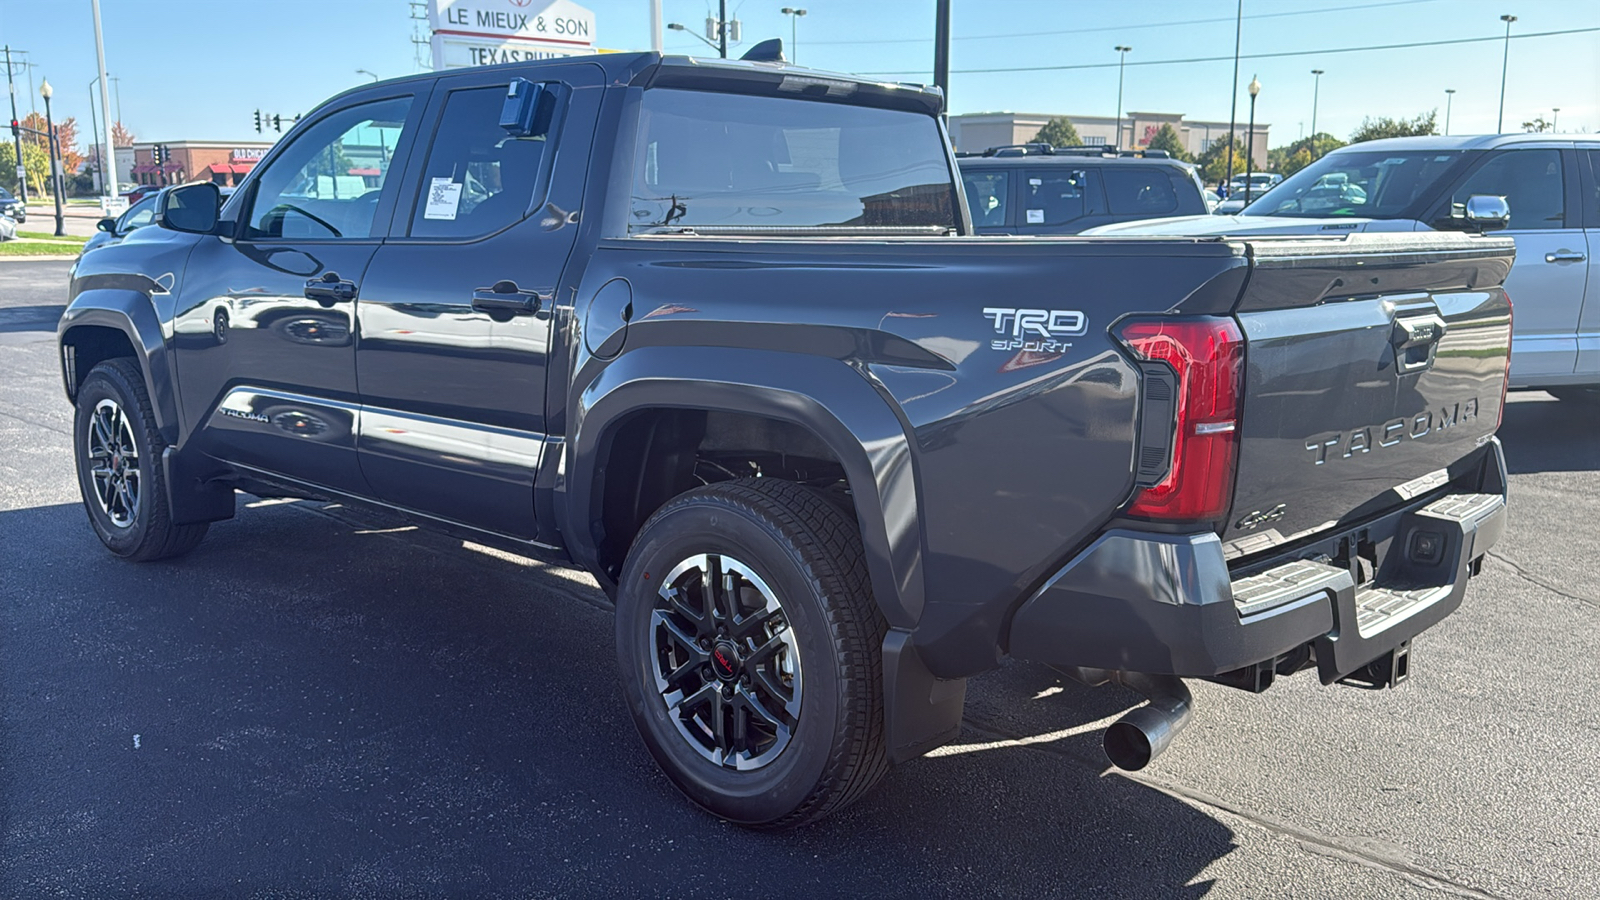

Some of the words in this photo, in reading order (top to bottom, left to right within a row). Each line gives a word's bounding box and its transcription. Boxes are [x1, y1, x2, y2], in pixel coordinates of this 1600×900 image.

[447, 7, 469, 25] LE
[477, 10, 529, 31] MIEUX
[536, 16, 547, 33] &
[555, 18, 589, 36] SON
[469, 47, 520, 65] TEXAS
[234, 149, 246, 158] OLD
[983, 307, 1088, 338] TRD
[991, 340, 1073, 353] SPORT
[219, 407, 271, 423] TACOMA
[1305, 398, 1479, 465] TACOMA
